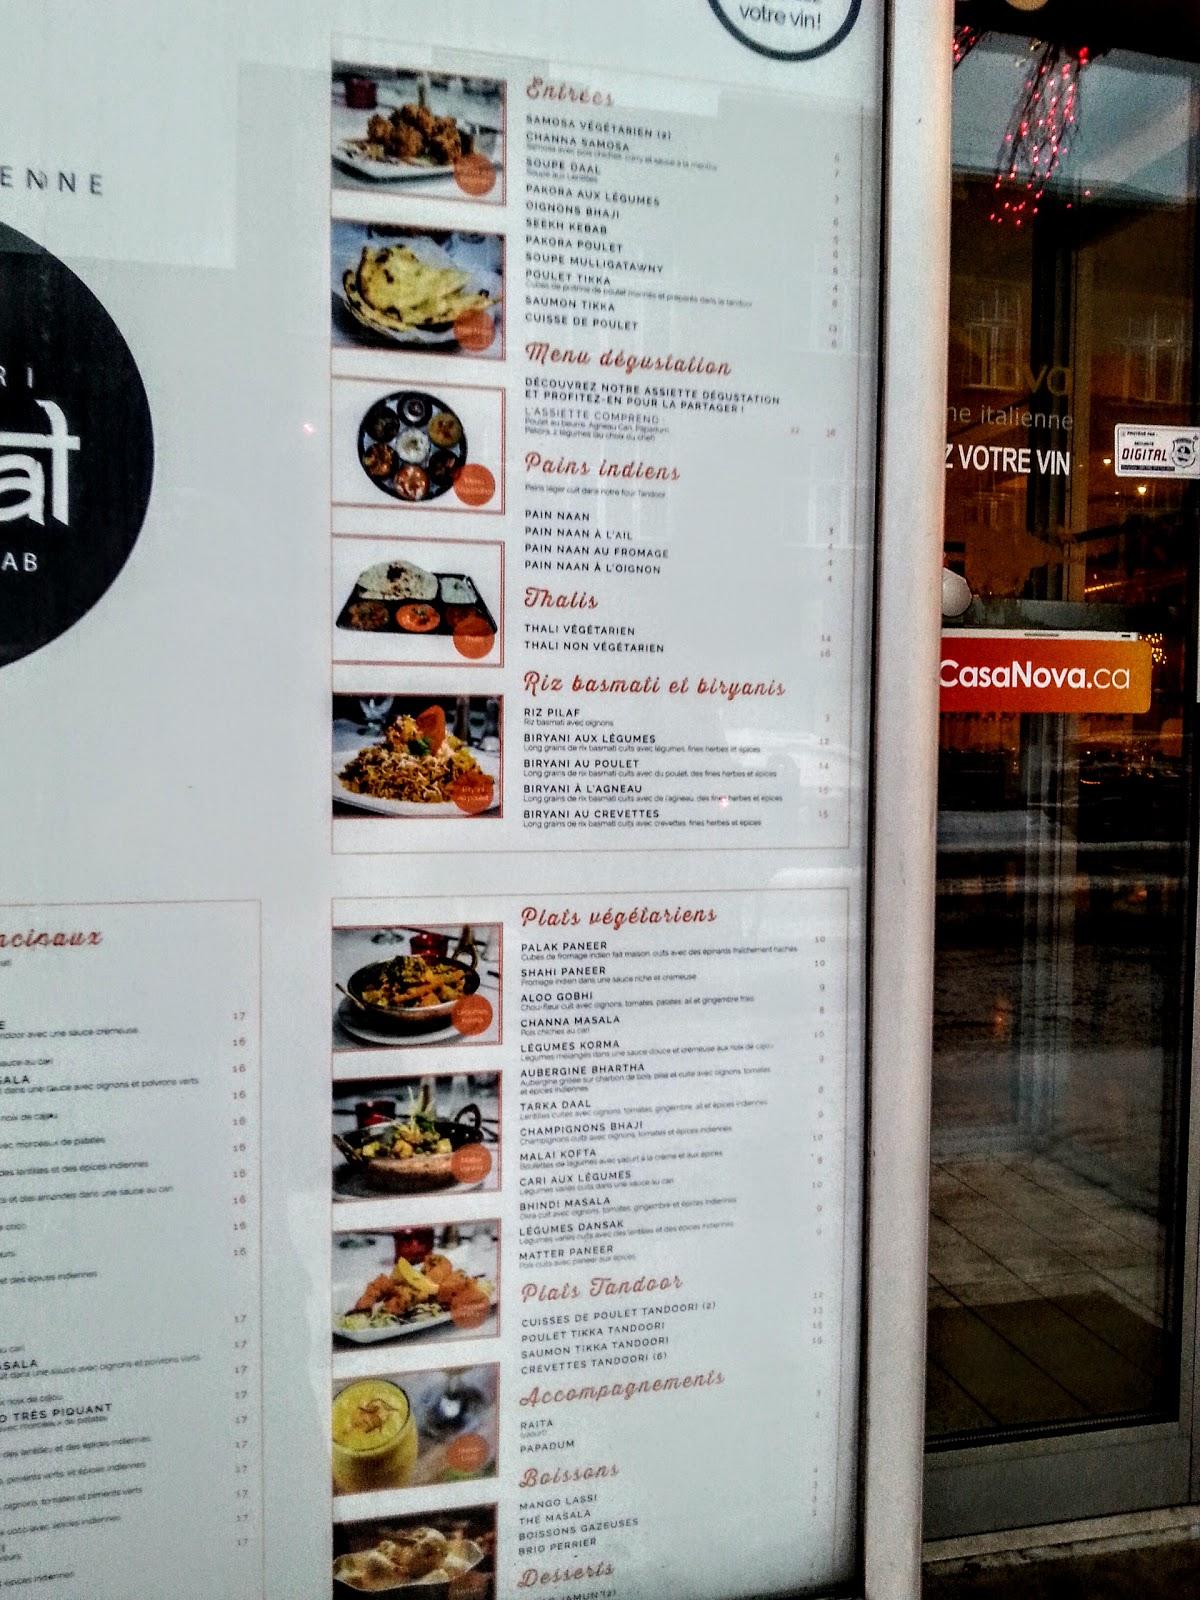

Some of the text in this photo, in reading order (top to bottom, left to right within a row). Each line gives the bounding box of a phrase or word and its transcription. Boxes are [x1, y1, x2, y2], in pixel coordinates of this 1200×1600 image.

[740, 4, 821, 30] votre vin!
[526, 132, 629, 151] CHANNA SAMOSA
[570, 223, 607, 234] KEBAB
[526, 235, 623, 253] PAKORA POULET
[526, 252, 663, 273] SOUPE MULLIGATAWNY
[526, 270, 610, 285] POULET TIKKA
[526, 296, 615, 311] SAUMON TIKKA
[525, 313, 638, 331] CUISSE DE POULET
[526, 342, 732, 376] Menu dégustation
[525, 377, 780, 404] DÉCOUVREZ NOTRE ASSIETTE DÉGUSTATION
[526, 390, 537, 398] ET
[544, 391, 621, 405] PROFITEZ-EN
[681, 402, 737, 412] PARTAGER
[981, 405, 1072, 431] italienne
[959, 444, 1031, 473] VOTRE
[1036, 449, 1070, 475] VIN
[1122, 448, 1167, 461] DIGITAL
[525, 452, 680, 480] Pains indiens
[525, 510, 590, 521] PAIN NAAN
[525, 527, 551, 536] PAIN
[557, 529, 589, 538] NAAN
[607, 531, 632, 540] L'AIL
[525, 544, 551, 553] PAIN
[557, 546, 589, 555] NAAN
[615, 548, 668, 558] FROMAGE
[525, 560, 551, 569] PAIN
[557, 562, 589, 571] NAAN
[606, 564, 660, 574] L'OIGNON
[524, 587, 598, 609] Thalis
[525, 624, 635, 635] THALI VÉGÉTARIEN
[525, 641, 664, 652] THALI NON VÉGÉTARIEN
[939, 660, 1130, 689] CasaNova.ca
[524, 671, 786, 701] Riz basmati et biryanis
[524, 708, 580, 717] RIZ PILAF
[524, 734, 570, 742] BIRYANI
[603, 733, 656, 743] LÉGUMES
[524, 760, 639, 768] BIRYANI AU POULET
[524, 785, 570, 793] BIRYANI
[587, 785, 642, 793] L'AGNEAU
[524, 810, 569, 818] BIRYANI
[595, 810, 659, 818] CREVETTES
[521, 906, 717, 931] Plats végétariens
[522, 944, 557, 952] PALAK
[563, 942, 607, 950] PANEER
[521, 969, 556, 977] SHAHI
[562, 967, 606, 975] PANEER
[521, 992, 593, 1002] ALOO GOBHI
[232, 1012, 246, 1021] 17
[521, 1016, 620, 1027] CHANNA MASALA
[233, 1037, 246, 1046] 16
[521, 1040, 619, 1052] LÉGUMES KORMA
[521, 1064, 644, 1077] AUBERGINE BHARTHA
[520, 1100, 591, 1111] TARKA DAAL
[520, 1121, 643, 1136] CHAMPIGNONS BHAJI
[520, 1149, 596, 1161] MALAI KOFTA
[520, 1170, 631, 1186] CARI AUX LÉGUMES
[520, 1197, 610, 1211] BHINDI MASALA
[520, 1220, 624, 1236] LÉGUMES DANSAK
[520, 1245, 613, 1260] MATTER PANEER
[521, 1275, 683, 1303] Plats Tandoor
[234, 1314, 247, 1323] 17
[522, 1317, 570, 1327] CUISSES
[575, 1314, 589, 1322] DE
[594, 1309, 637, 1320] POULET
[642, 1303, 698, 1315] TANDOORI
[522, 1322, 665, 1343] POULET TIKKA TANDOORI
[522, 1337, 668, 1359] SAUMON TIKKA TANDOORI
[521, 1360, 587, 1374] CREVETTES
[592, 1354, 648, 1366] TANDOORI
[520, 1370, 725, 1407] Accompagnements
[53, 1403, 112, 1416] PIQUANT
[521, 1419, 553, 1430] RAITA
[520, 1440, 575, 1453] PAPADUM
[519, 1464, 620, 1488] Boissons
[519, 1494, 597, 1510] MANGO LASSI
[546, 1510, 591, 1521] MASALA
[519, 1518, 638, 1541] BOISSONS GAZEUSES
[550, 1538, 596, 1551] PERRIER
[517, 1561, 615, 1587] Desserts
